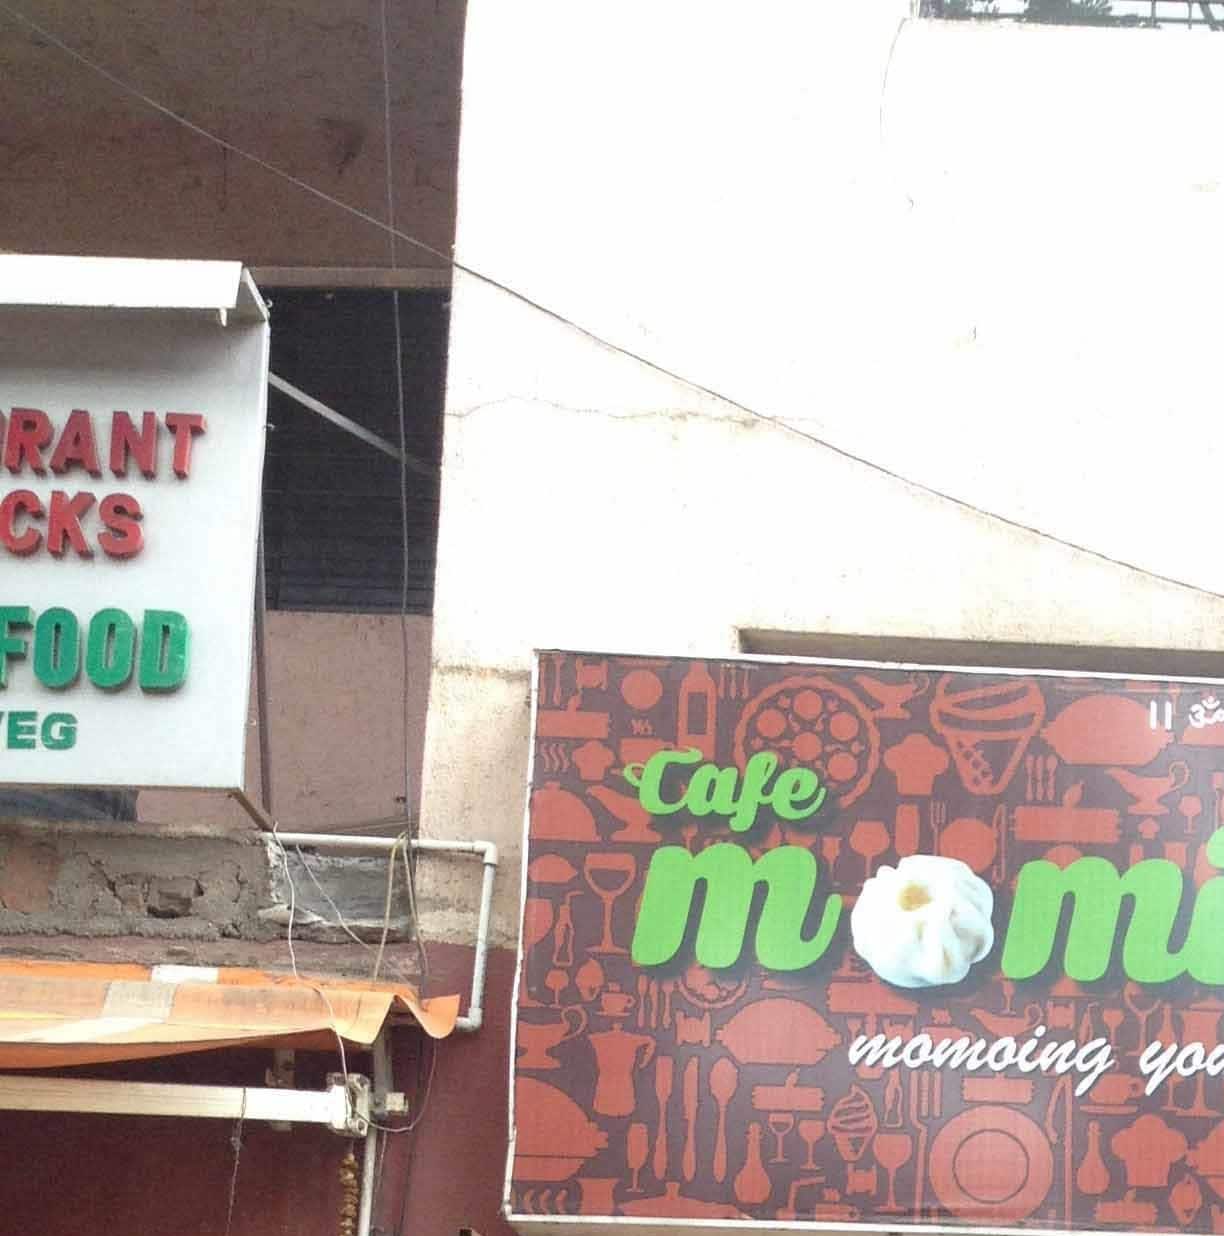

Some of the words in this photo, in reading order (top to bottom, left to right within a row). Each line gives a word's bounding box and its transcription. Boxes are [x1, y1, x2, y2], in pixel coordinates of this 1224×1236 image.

[0, 408, 207, 479] RANT
[0, 489, 144, 559] CKS
[0, 606, 192, 692] FOOD
[0, 711, 78, 750] EG
[623, 747, 827, 833] Cafe
[846, 1024, 1115, 1100] momoing
